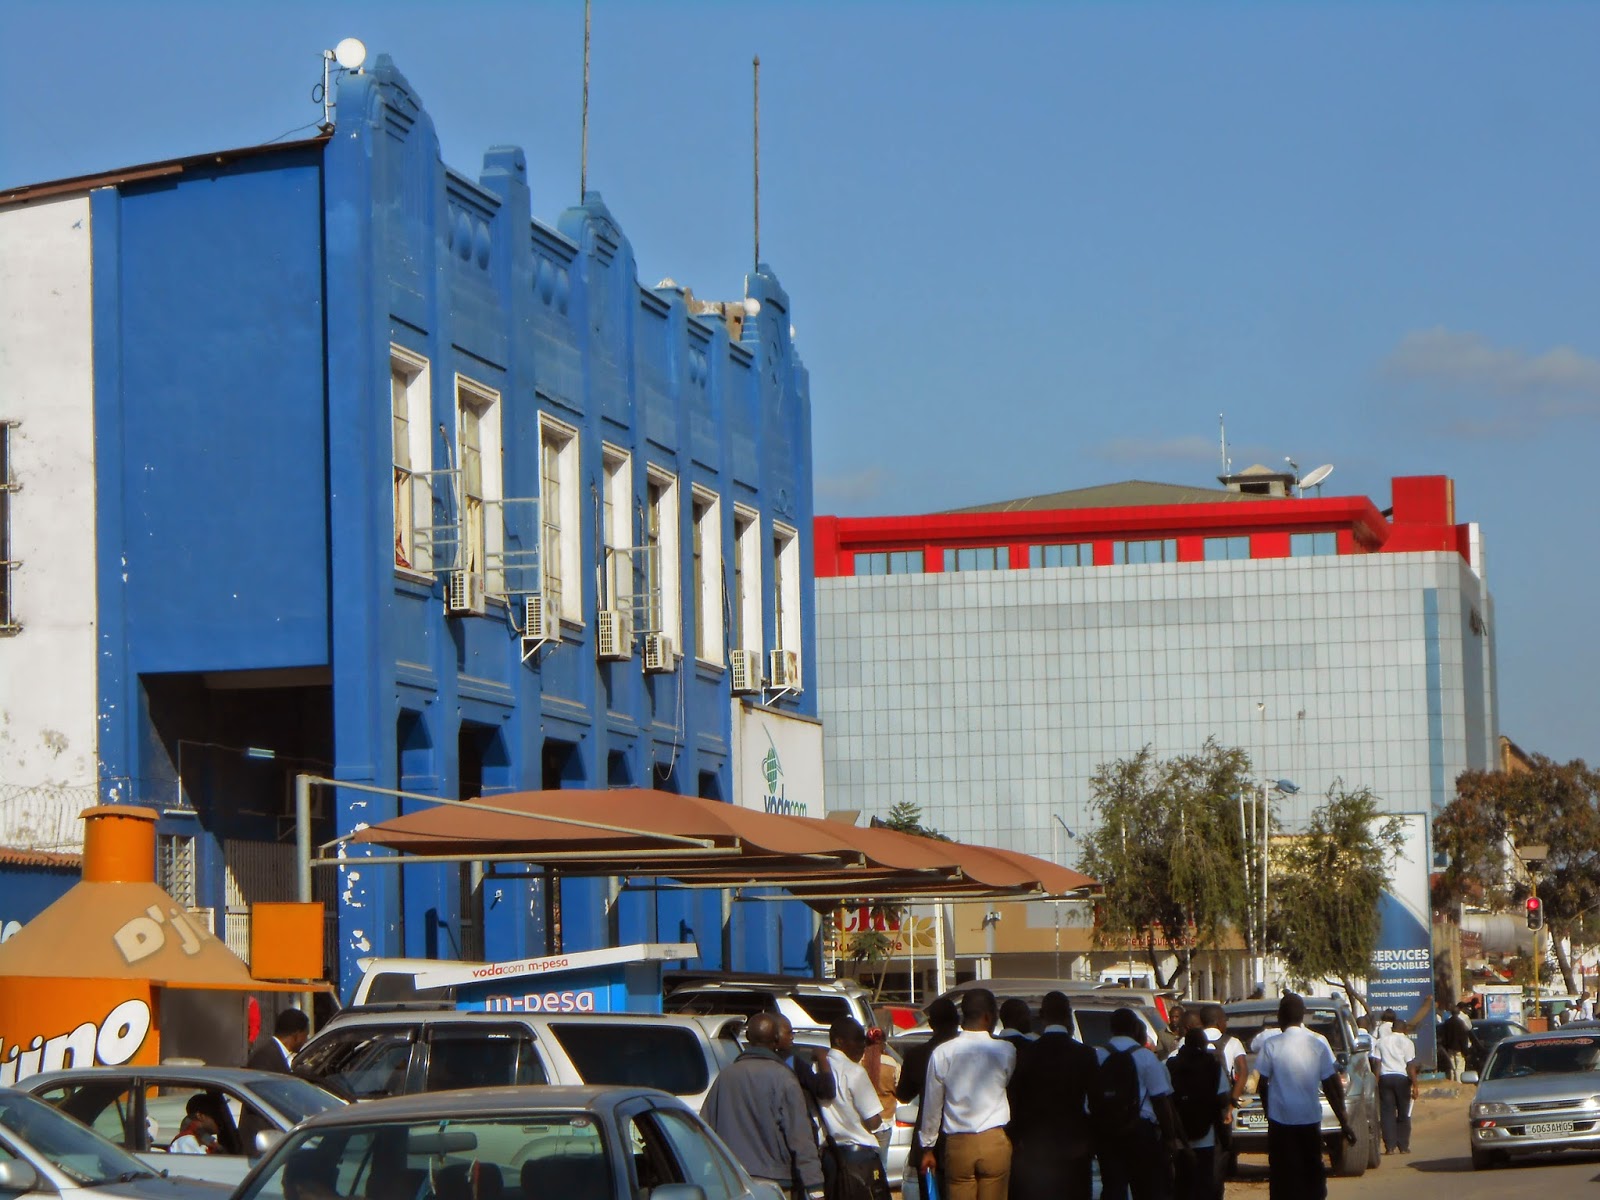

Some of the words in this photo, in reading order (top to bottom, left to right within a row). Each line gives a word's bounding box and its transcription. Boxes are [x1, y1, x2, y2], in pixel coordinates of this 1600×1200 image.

[764, 783, 807, 817] vodacom
[1371, 949, 1430, 961] SERVICES
[473, 964, 525, 978] vodacom
[528, 959, 569, 971] m-pesa
[485, 991, 595, 1012] m-pesa
